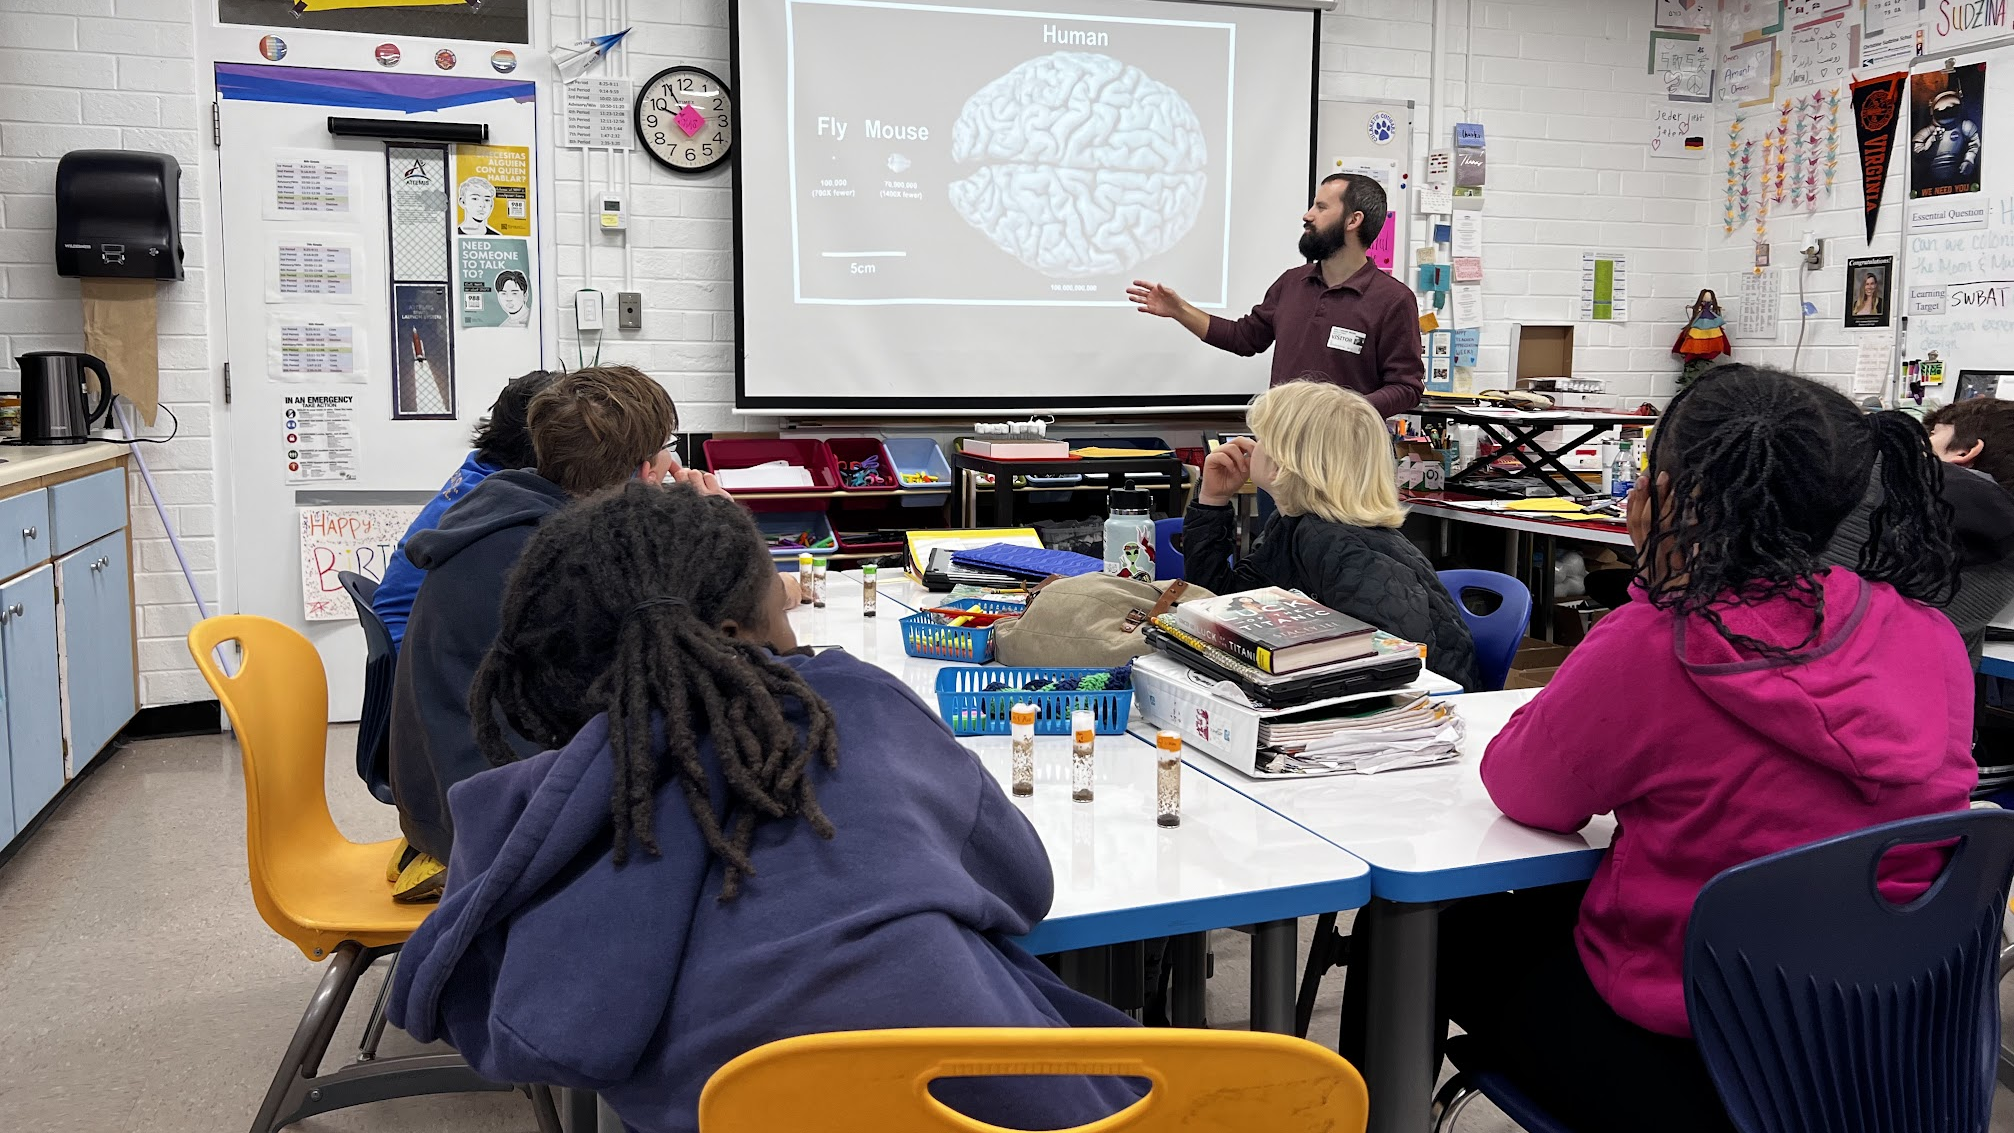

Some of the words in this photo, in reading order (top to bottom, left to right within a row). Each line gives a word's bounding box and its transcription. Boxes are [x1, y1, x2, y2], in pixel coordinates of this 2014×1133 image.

[1043, 24, 1109, 47] Human
[661, 84, 673, 97] 11
[677, 78, 693, 91] 12
[650, 98, 667, 111] 10
[712, 98, 724, 111] 2
[646, 114, 658, 128] 9
[717, 114, 729, 127] 3
[817, 116, 848, 141] Fly
[865, 119, 929, 141] Mouse
[654, 131, 666, 145] 8
[712, 131, 724, 144] 4
[667, 143, 677, 156] 7
[685, 148, 696, 161] 6
[702, 143, 713, 156] 5
[488, 159, 526, 168] ALGUIEN
[475, 166, 496, 174] CON
[498, 167, 526, 175] QUIEN
[1864, 134, 1889, 212] VIRGINIA
[487, 174, 527, 183] HABLAR?
[1921, 187, 1933, 197] WE
[1934, 185, 1953, 195] NEED
[1954, 183, 1970, 193] YOU
[1912, 210, 1947, 222] Essential
[1948, 208, 1984, 220] Question
[462, 241, 491, 250] NEED
[462, 250, 519, 261] SOMEONE
[1848, 256, 1893, 267] Congratulations!
[462, 260, 478, 269] TO
[480, 260, 506, 270] TALK
[850, 262, 876, 274] 5cm
[462, 269, 484, 278] TO?
[1911, 289, 1945, 299] Learning
[1951, 286, 2011, 307] SWBAT
[1916, 302, 1940, 313] Target
[1331, 334, 1353, 344] VISITOR
[285, 396, 293, 404] IN
[294, 396, 306, 404] AN
[307, 395, 353, 404] EMERGENCY
[1216, 599, 1309, 622] LUCK
[1238, 610, 1330, 632] TITANIC
[1196, 625, 1217, 643] LUCK
[1228, 640, 1256, 662] TITANI
